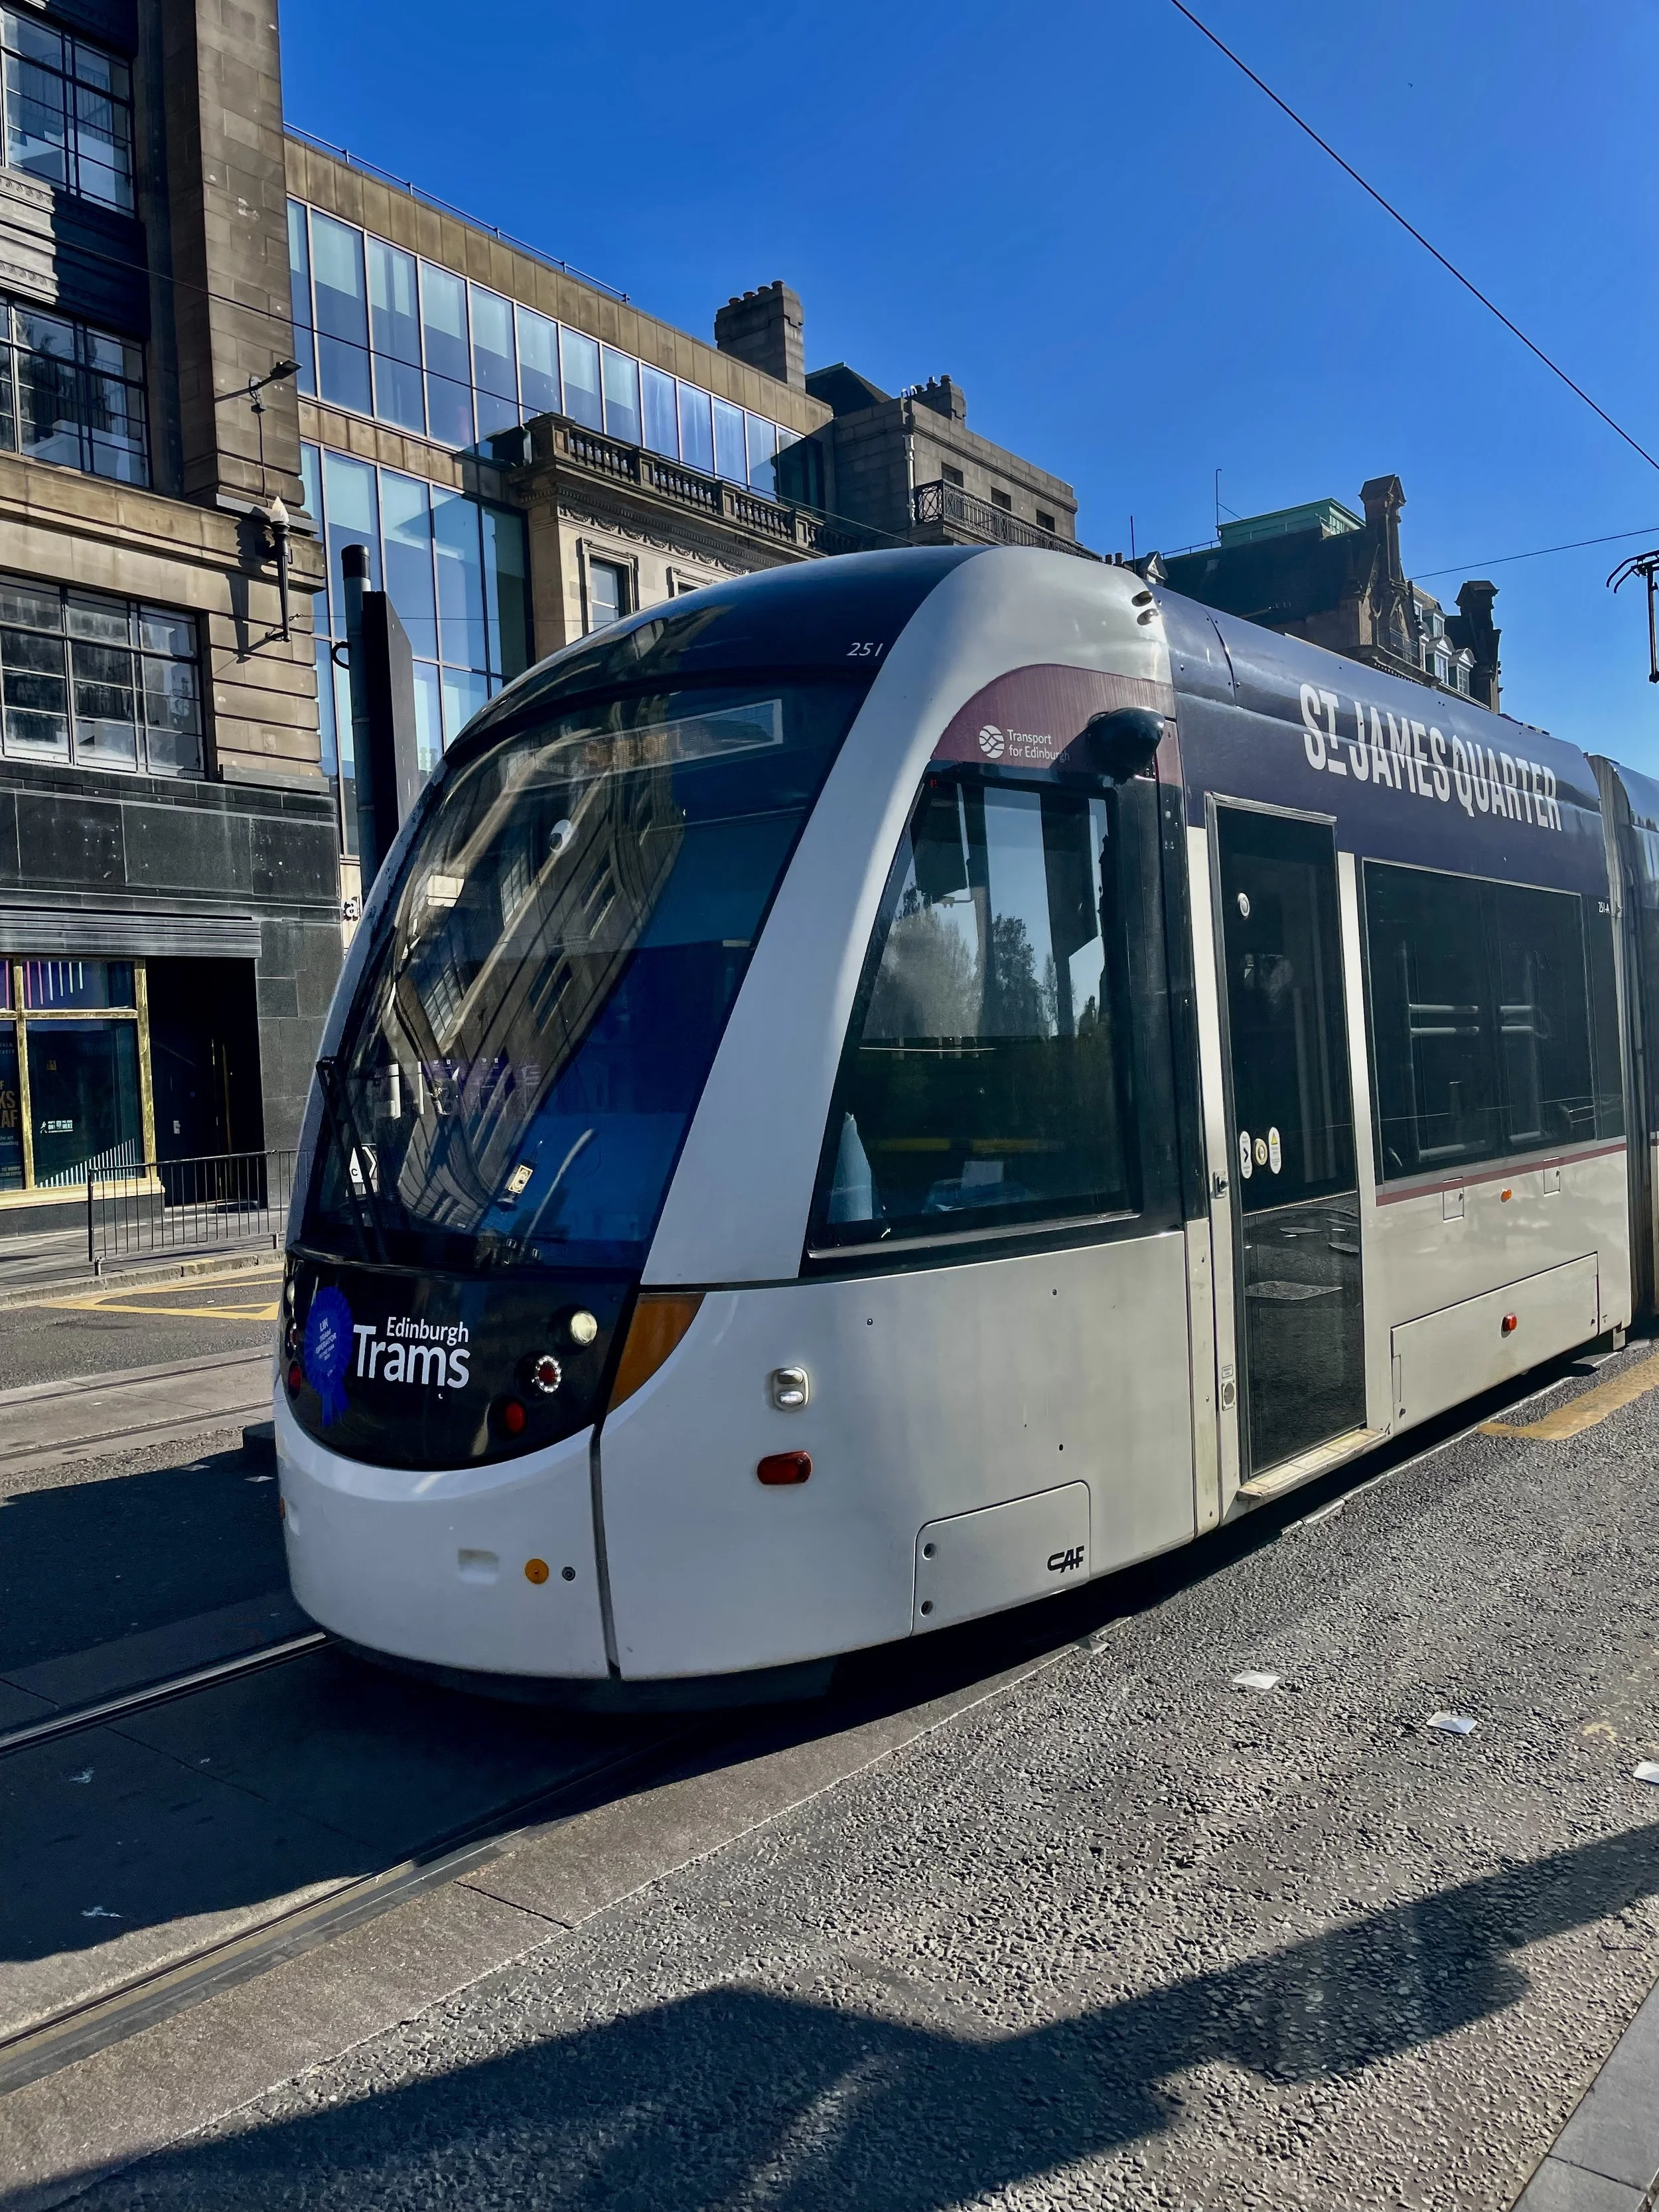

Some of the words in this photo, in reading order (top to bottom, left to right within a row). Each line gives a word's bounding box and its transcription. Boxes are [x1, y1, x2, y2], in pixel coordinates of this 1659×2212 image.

[846, 642, 884, 657] 251
[1007, 729, 1052, 745] Transport
[1009, 744, 1023, 757] for
[1025, 745, 1070, 763] Edinburgh
[1349, 701, 1451, 802] JAMES
[1452, 734, 1562, 832] QUARTER
[386, 1316, 469, 1347] Edinburgh
[353, 1324, 471, 1388] Trams
[1047, 1545, 1084, 1574] CAF
